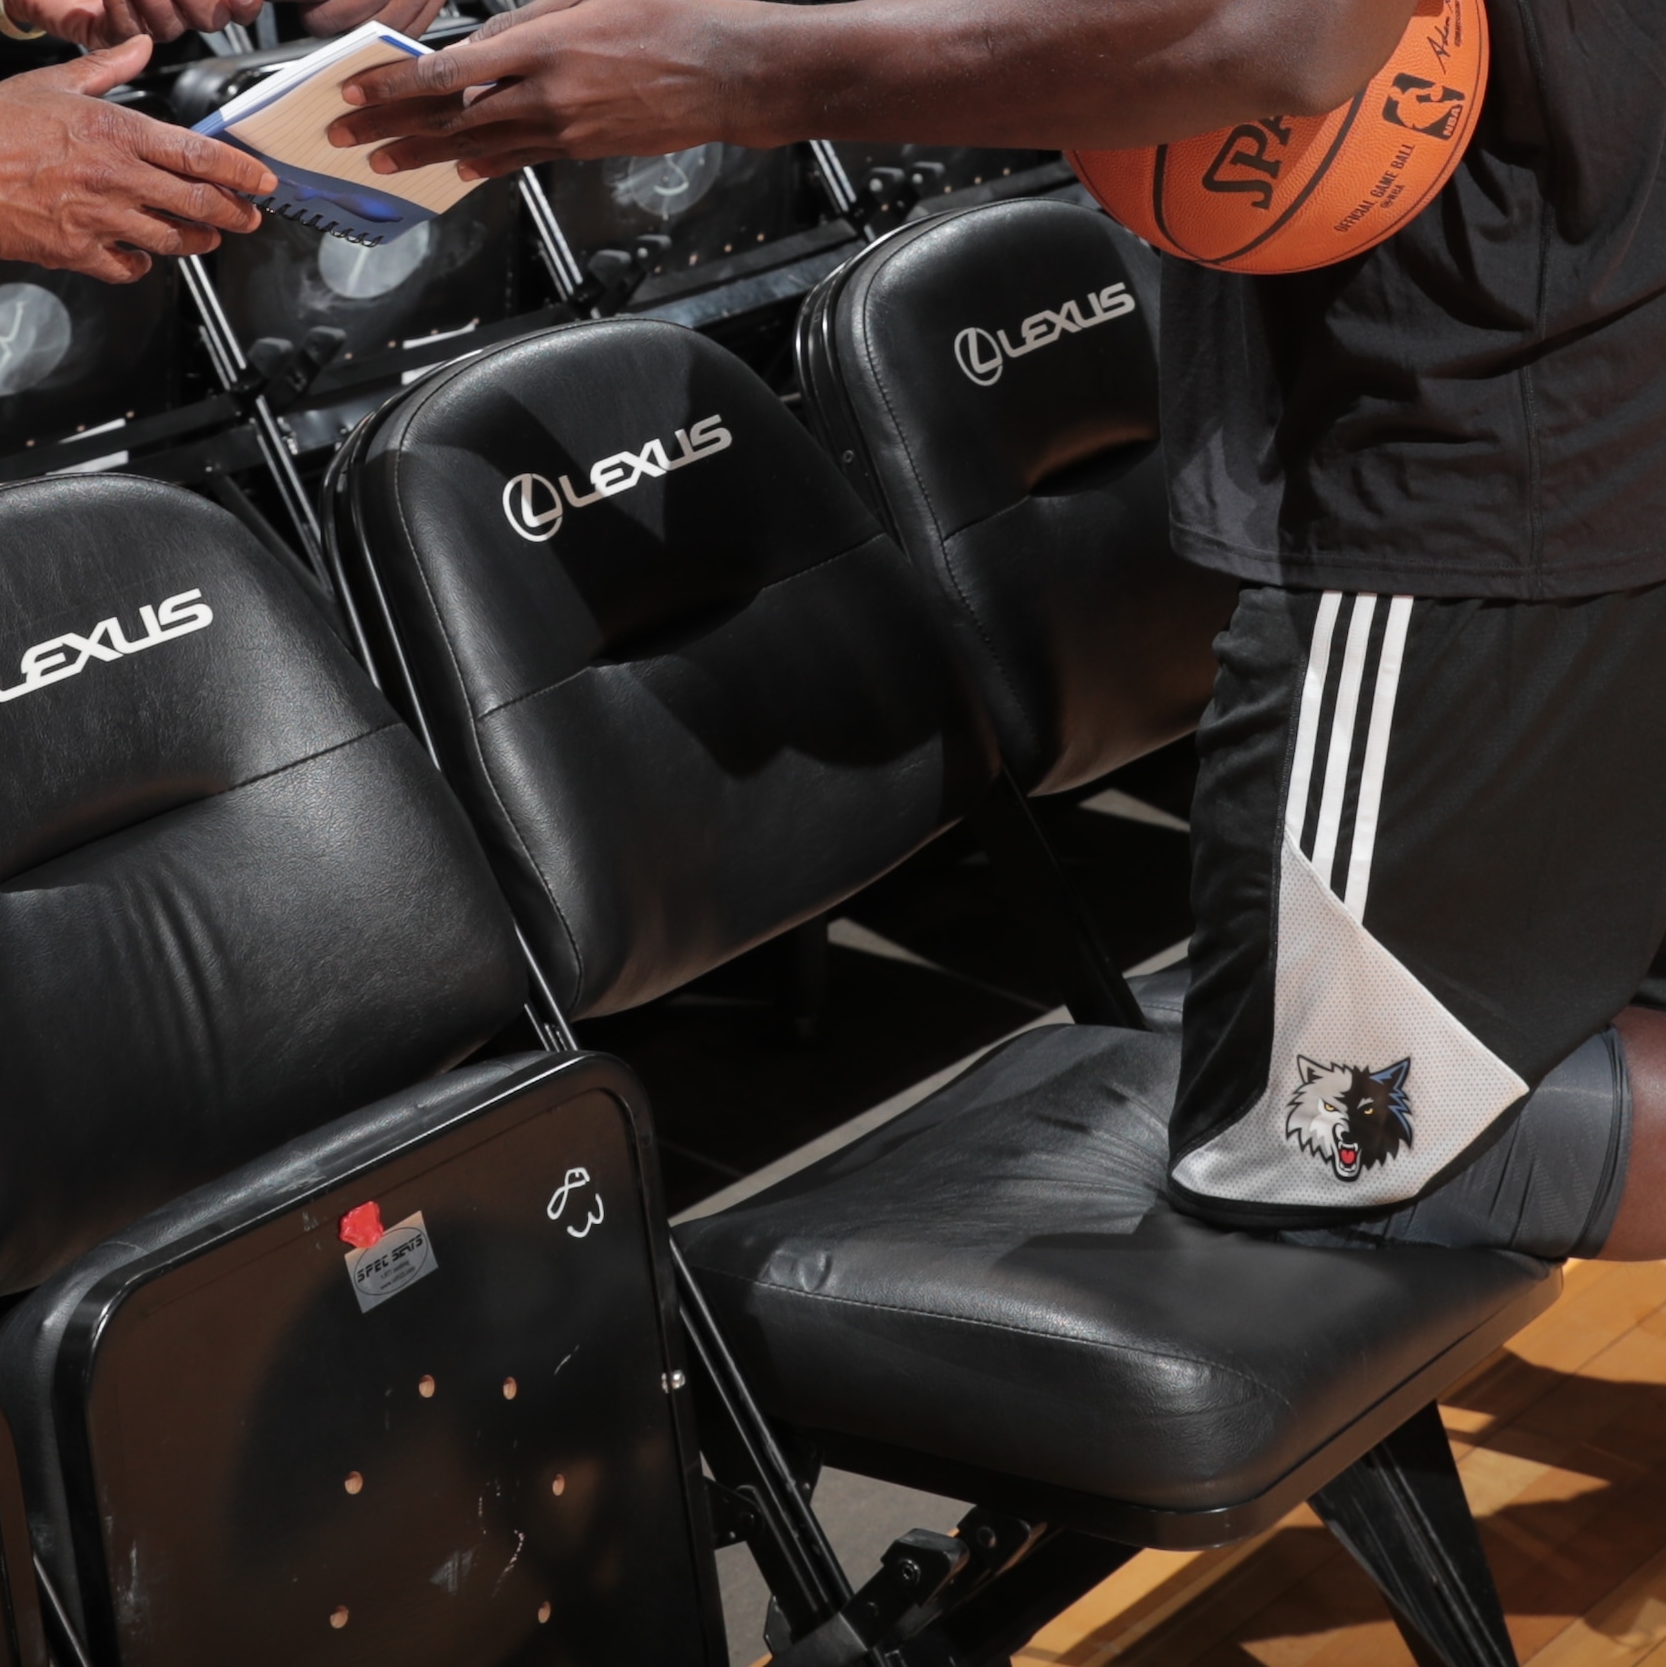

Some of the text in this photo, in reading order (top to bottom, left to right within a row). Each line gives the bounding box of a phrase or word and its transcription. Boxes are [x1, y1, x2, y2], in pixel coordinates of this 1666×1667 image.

[1442, 105, 1462, 137] NBA
[1334, 143, 1416, 233] OFFICIAL GAME BALL
[997, 282, 1135, 357] LEXUS
[559, 414, 732, 507] LEXUS
[356, 1233, 424, 1283] SPEC SEATS
